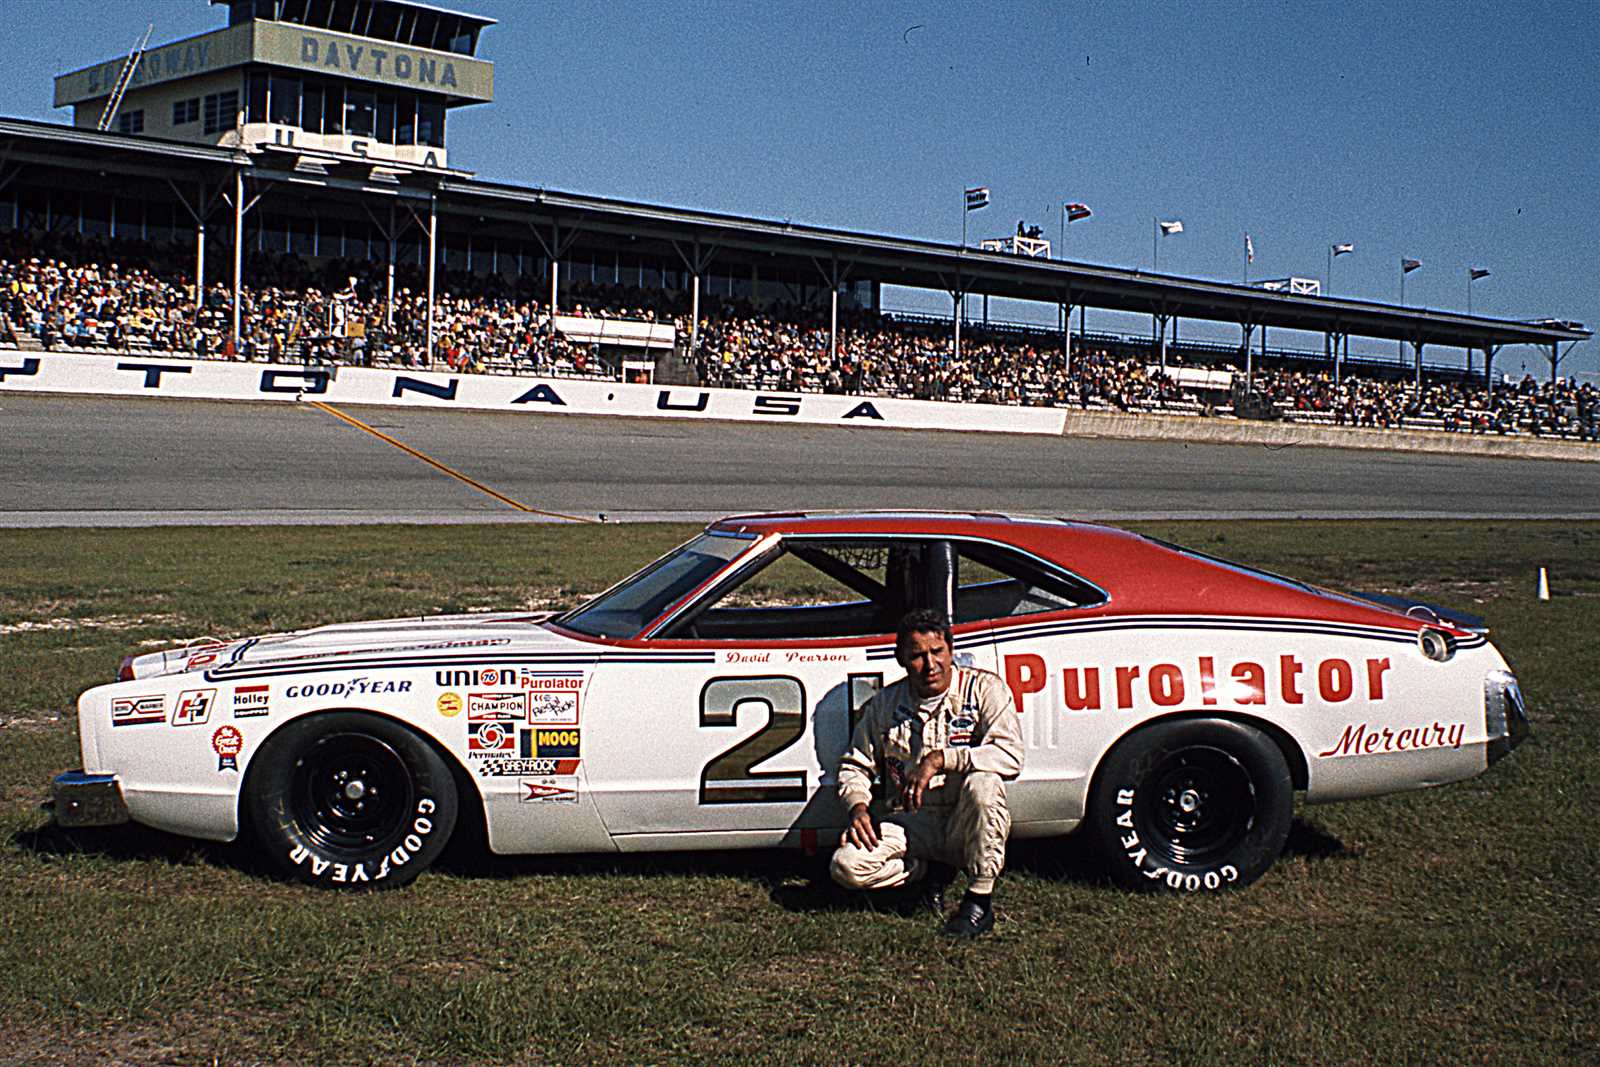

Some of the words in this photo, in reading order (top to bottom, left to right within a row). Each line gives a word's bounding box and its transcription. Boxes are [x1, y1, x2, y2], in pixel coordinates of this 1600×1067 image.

[302, 36, 458, 88] DAYTONA
[658, 390, 886, 420] USA
[725, 651, 771, 664] David
[785, 651, 849, 663] Pearson
[483, 673, 497, 685] 76
[521, 677, 584, 688] Purolator
[1003, 652, 1391, 712] Purolator
[234, 695, 269, 705] Holley
[471, 702, 523, 711] CHAMPION
[538, 731, 579, 746] MOOG
[1320, 722, 1466, 757] Mercury
[503, 760, 556, 772] GREY-ROCK
[1116, 788, 1239, 892] GOODYEAR
